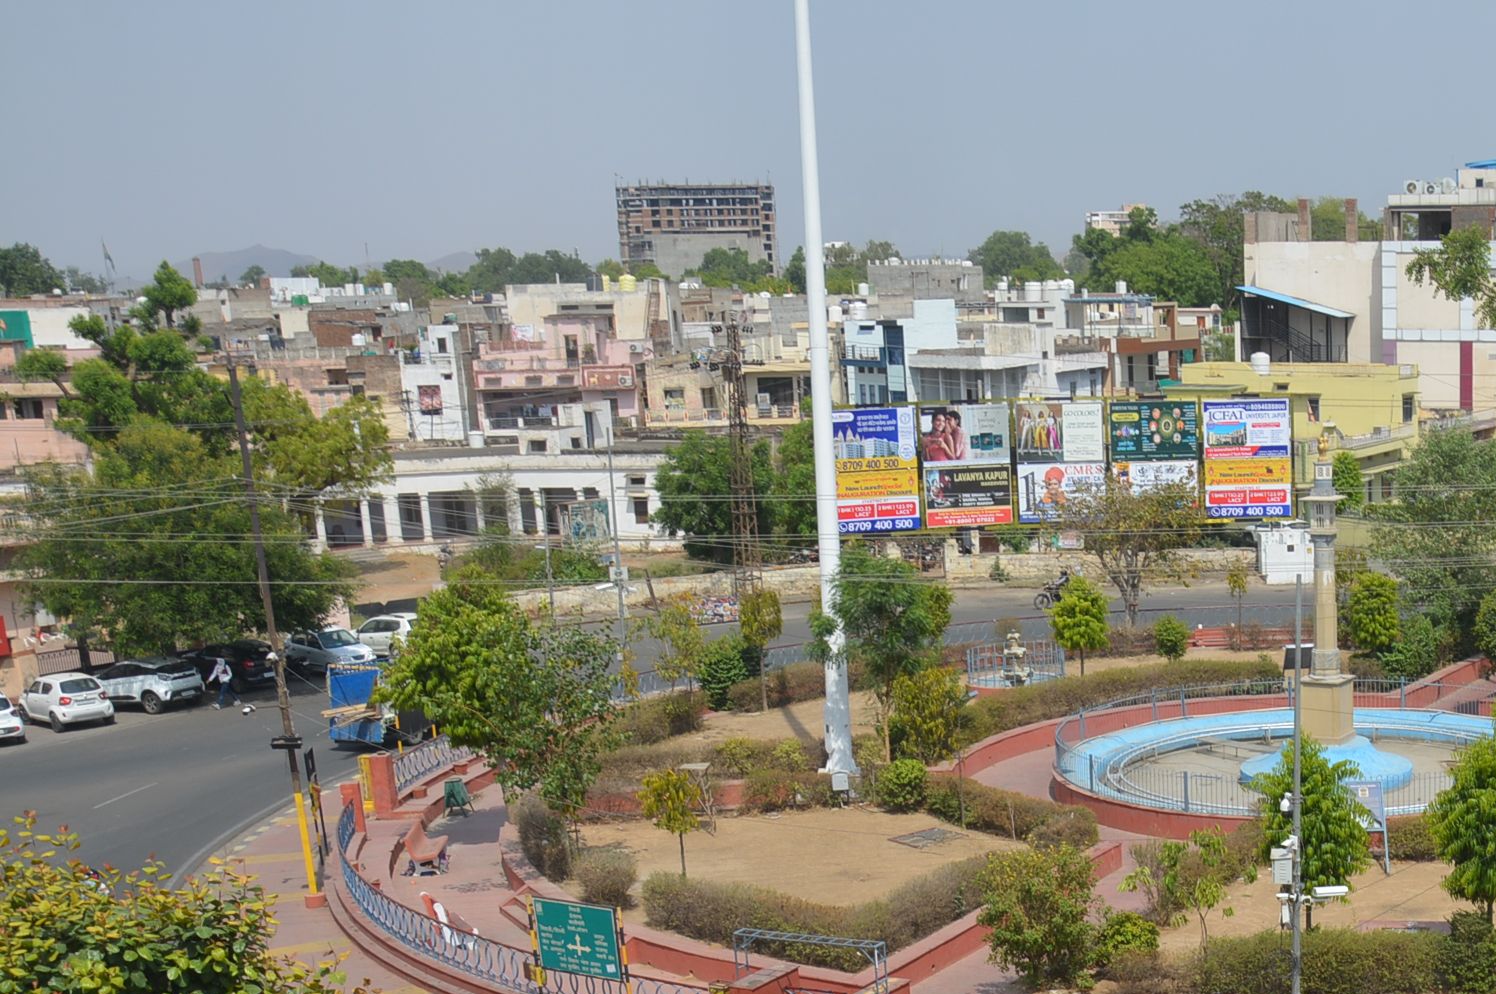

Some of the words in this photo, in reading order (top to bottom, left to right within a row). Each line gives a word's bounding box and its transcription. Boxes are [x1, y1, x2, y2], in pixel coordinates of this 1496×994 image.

[1208, 410, 1245, 420] ICFAI
[843, 461, 863, 470] 8709
[866, 460, 880, 469] 400
[884, 459, 899, 468] 500
[954, 472, 983, 482] LAVANYA
[985, 471, 1008, 480] KAPUR
[1221, 507, 1243, 516] 8709
[1246, 507, 1263, 515] 400
[1266, 506, 1283, 515] 500
[848, 521, 871, 531] 8709
[875, 520, 892, 529] 400
[895, 519, 913, 528] 500
